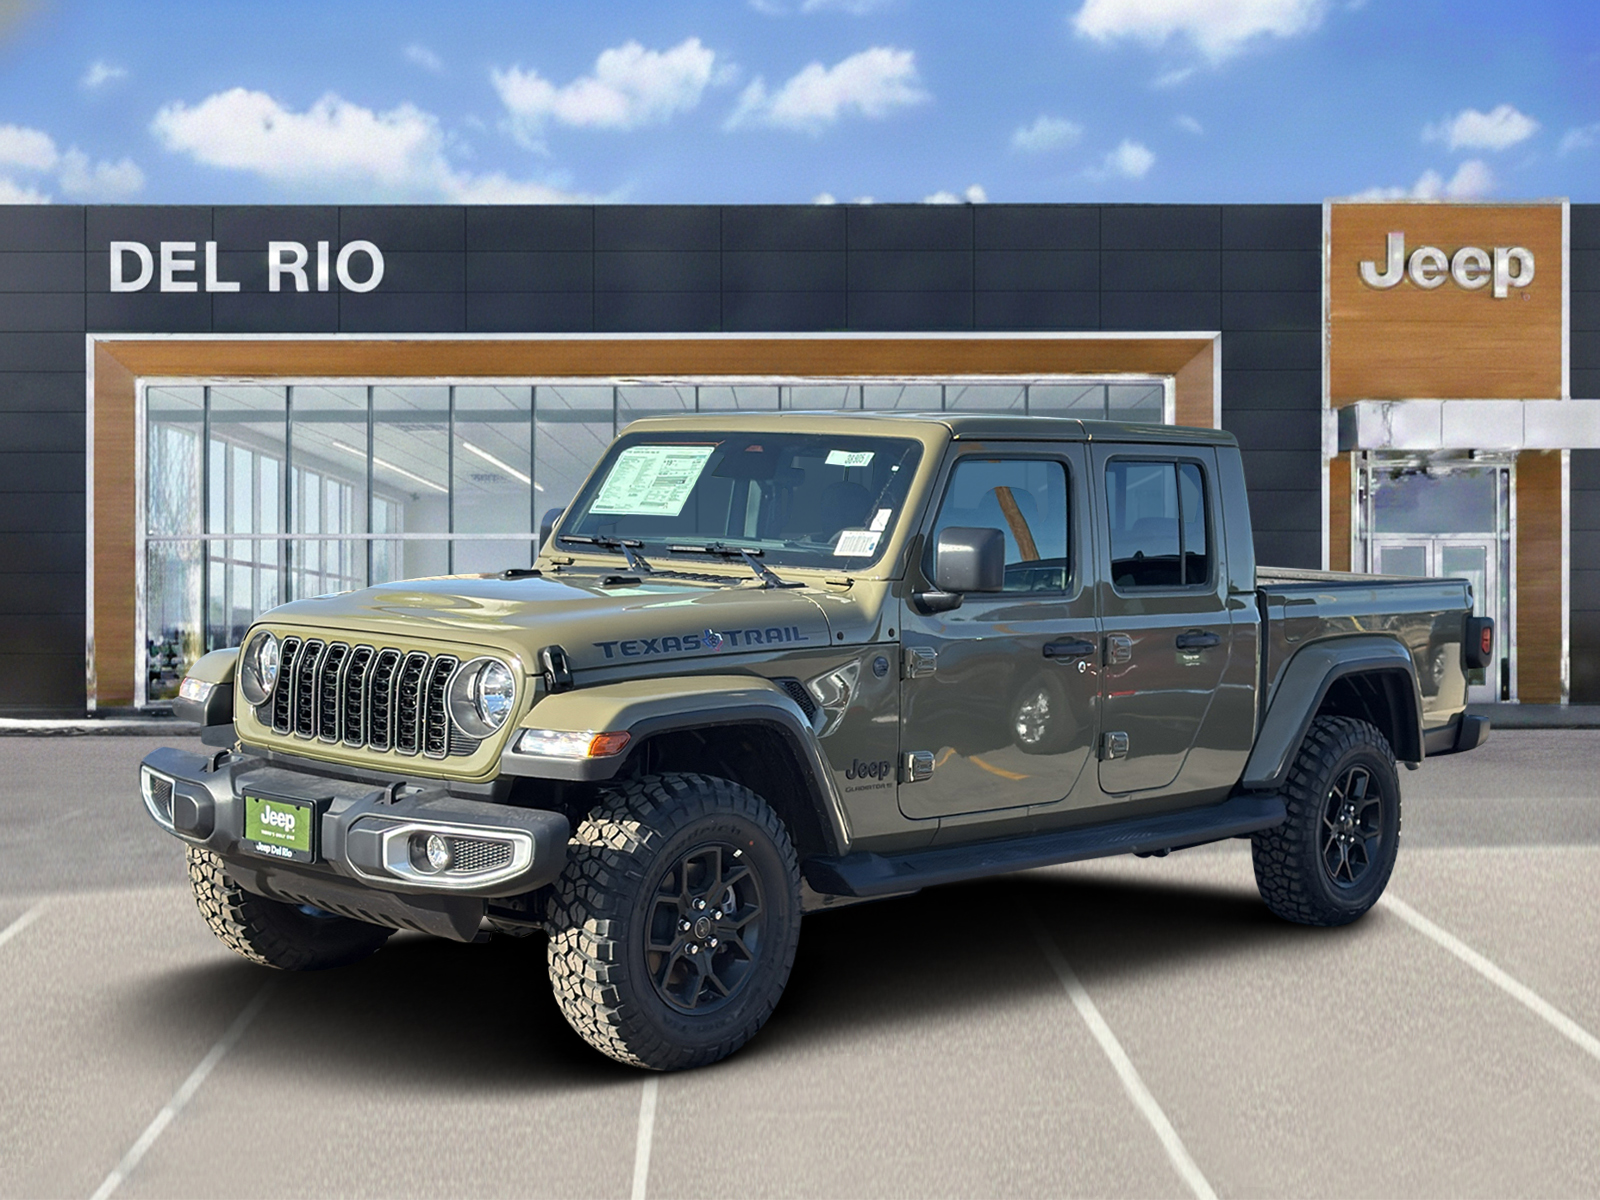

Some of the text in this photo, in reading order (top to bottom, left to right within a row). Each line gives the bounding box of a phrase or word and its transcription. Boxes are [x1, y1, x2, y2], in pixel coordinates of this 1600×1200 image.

[110, 240, 385, 293] DEL RIO
[1359, 231, 1535, 299] Jeep
[593, 626, 809, 659] TEXAS TRAIL
[845, 758, 891, 781] Jeep
[260, 804, 296, 832] Jeep
[256, 841, 293, 858] Jeep Del Rio
